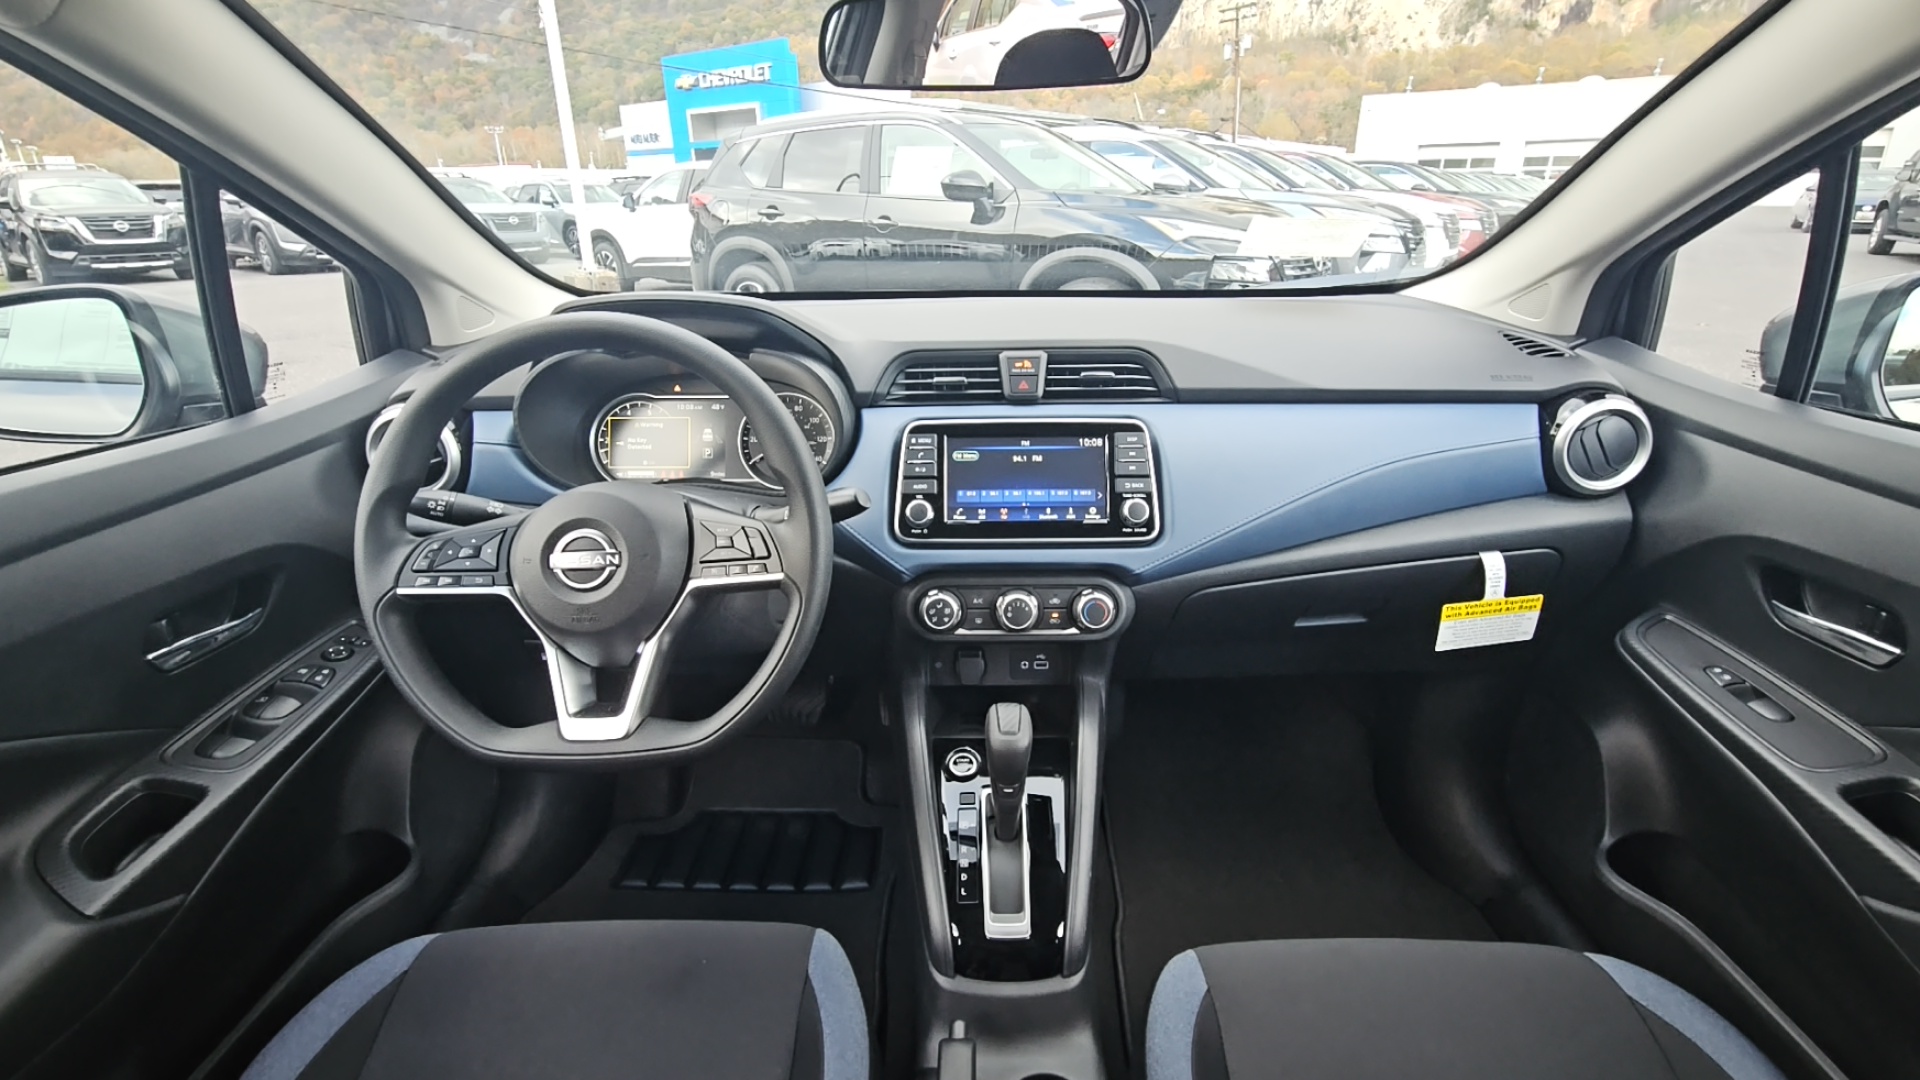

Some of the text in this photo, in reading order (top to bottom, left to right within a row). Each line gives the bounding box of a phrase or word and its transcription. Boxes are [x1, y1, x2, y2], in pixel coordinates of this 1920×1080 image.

[1079, 438, 1103, 447] 10:08
[1446, 605, 1462, 613] This
[1464, 602, 1493, 610] Vehicle
[1504, 597, 1541, 607] Equipped
[1445, 611, 1462, 619] with
[1464, 608, 1503, 617] Advanced
[1517, 603, 1538, 611] Bags
[960, 872, 968, 881] D
[960, 887, 967, 896] L
